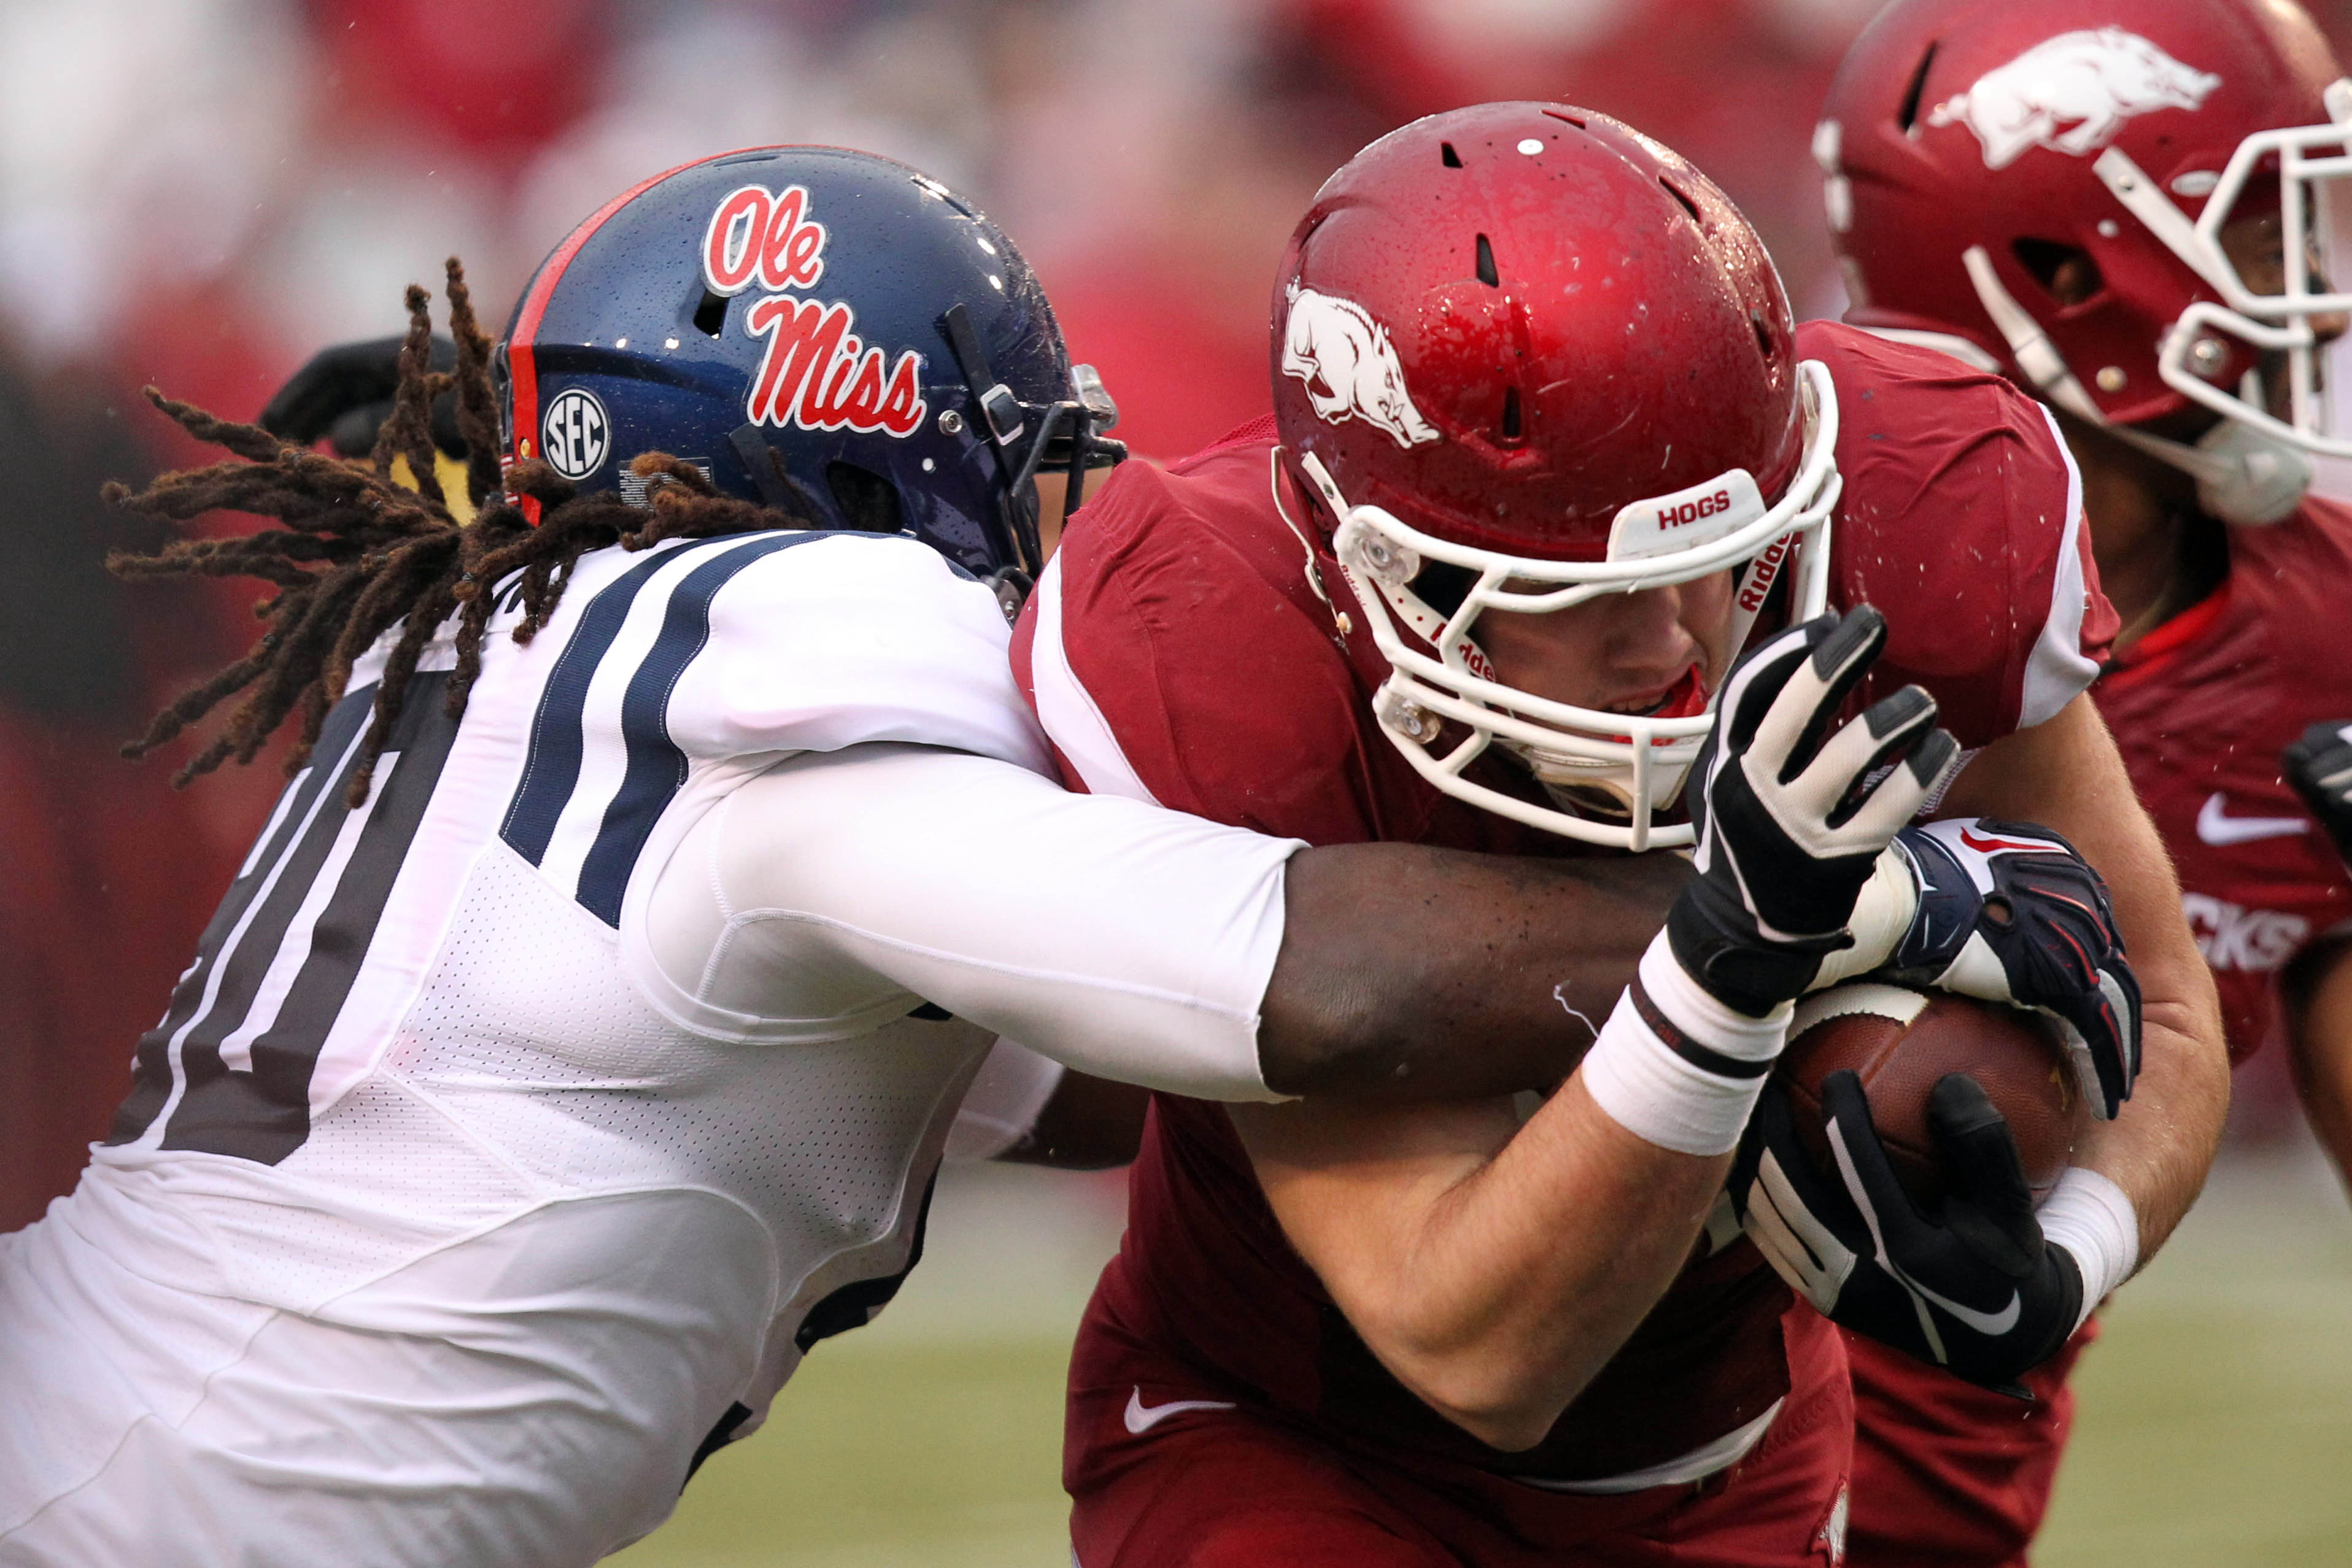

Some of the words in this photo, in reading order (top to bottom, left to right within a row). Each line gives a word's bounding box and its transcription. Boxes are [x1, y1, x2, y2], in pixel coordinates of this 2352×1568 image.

[703, 185, 827, 292] Ole
[747, 295, 927, 438] Miss
[547, 396, 605, 474] SEC
[1658, 490, 1730, 530] HOGS
